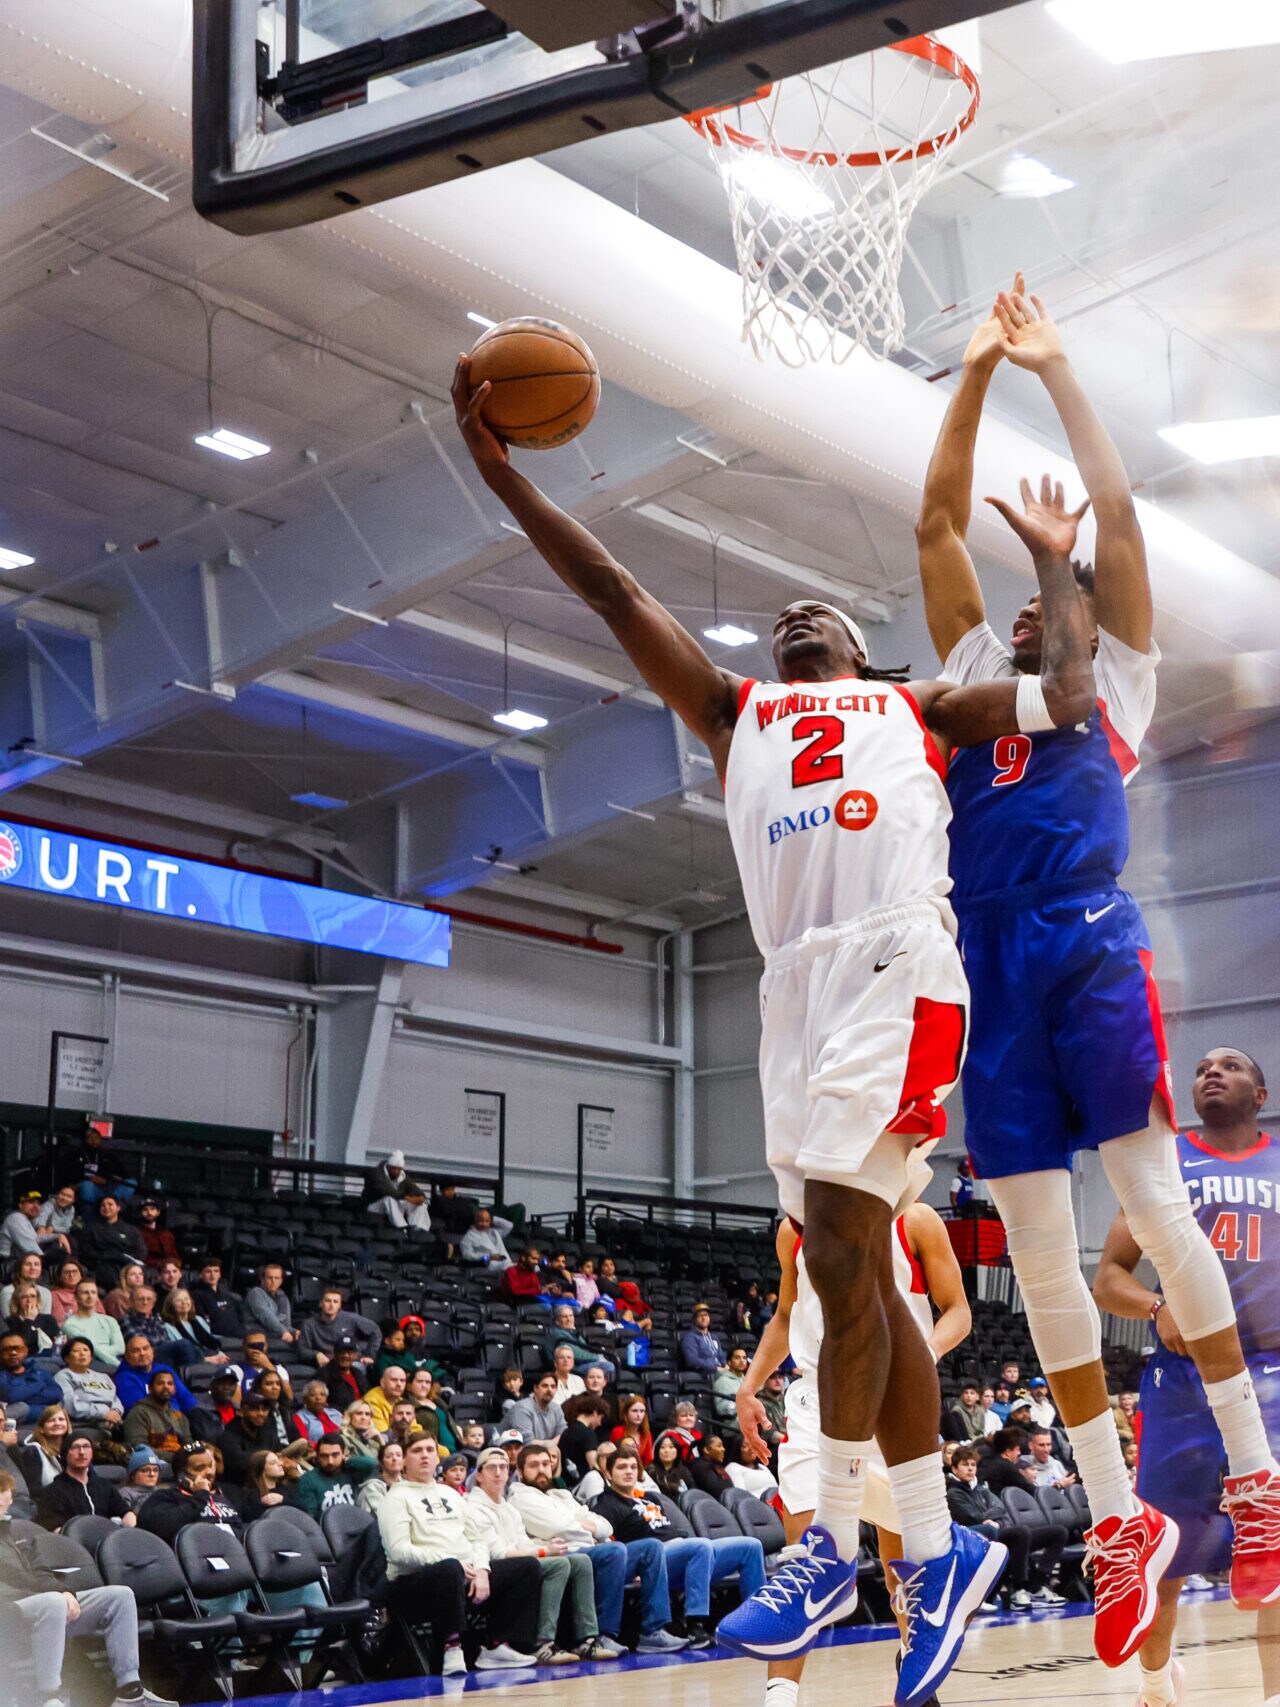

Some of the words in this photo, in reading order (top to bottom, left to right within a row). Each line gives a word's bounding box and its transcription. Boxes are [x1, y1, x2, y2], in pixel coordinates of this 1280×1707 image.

[756, 692, 832, 732] WINDY
[836, 693, 889, 716] CITY
[792, 715, 845, 789] 2
[992, 734, 1032, 787] 9
[767, 805, 831, 846] BMO
[1208, 1211, 1261, 1262] 41
